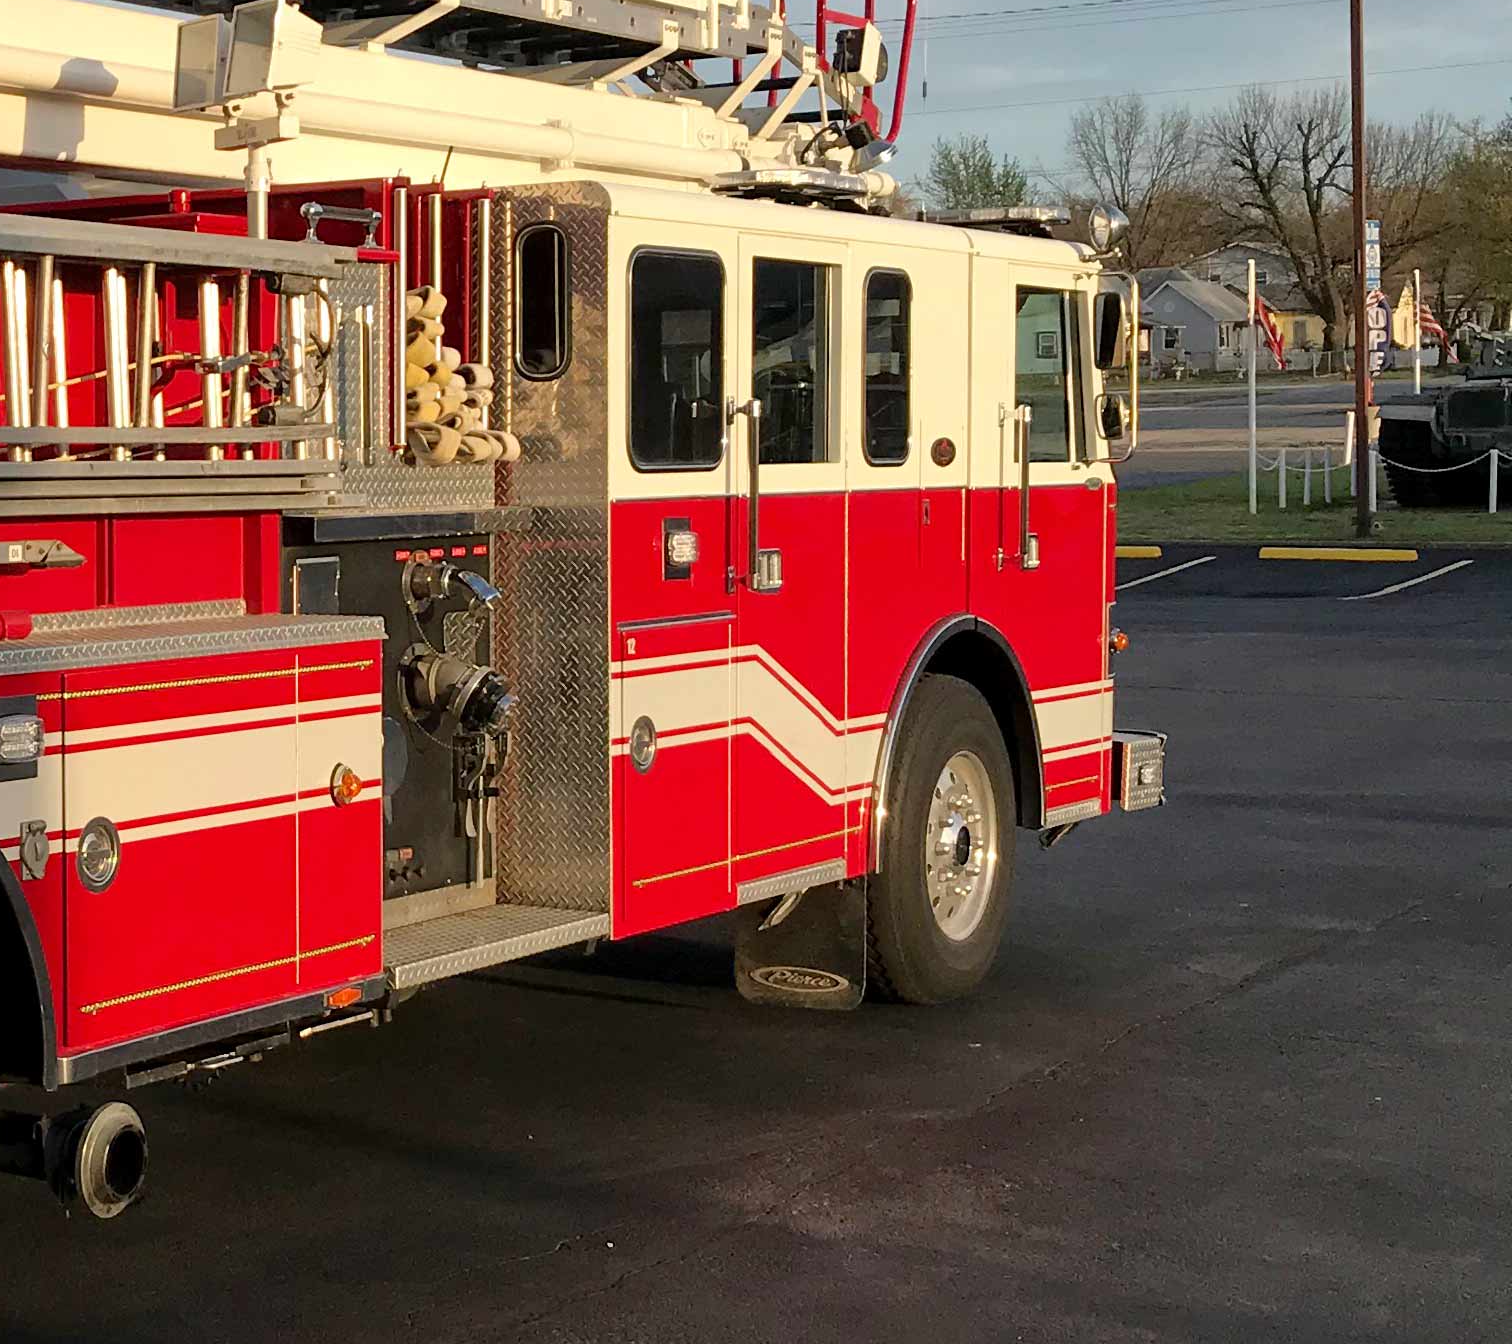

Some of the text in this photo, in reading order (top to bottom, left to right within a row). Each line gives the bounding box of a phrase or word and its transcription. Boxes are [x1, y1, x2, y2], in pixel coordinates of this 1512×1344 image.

[1367, 306, 1387, 378] OPE
[626, 637, 637, 655] 12
[768, 969, 832, 987] Pierce
